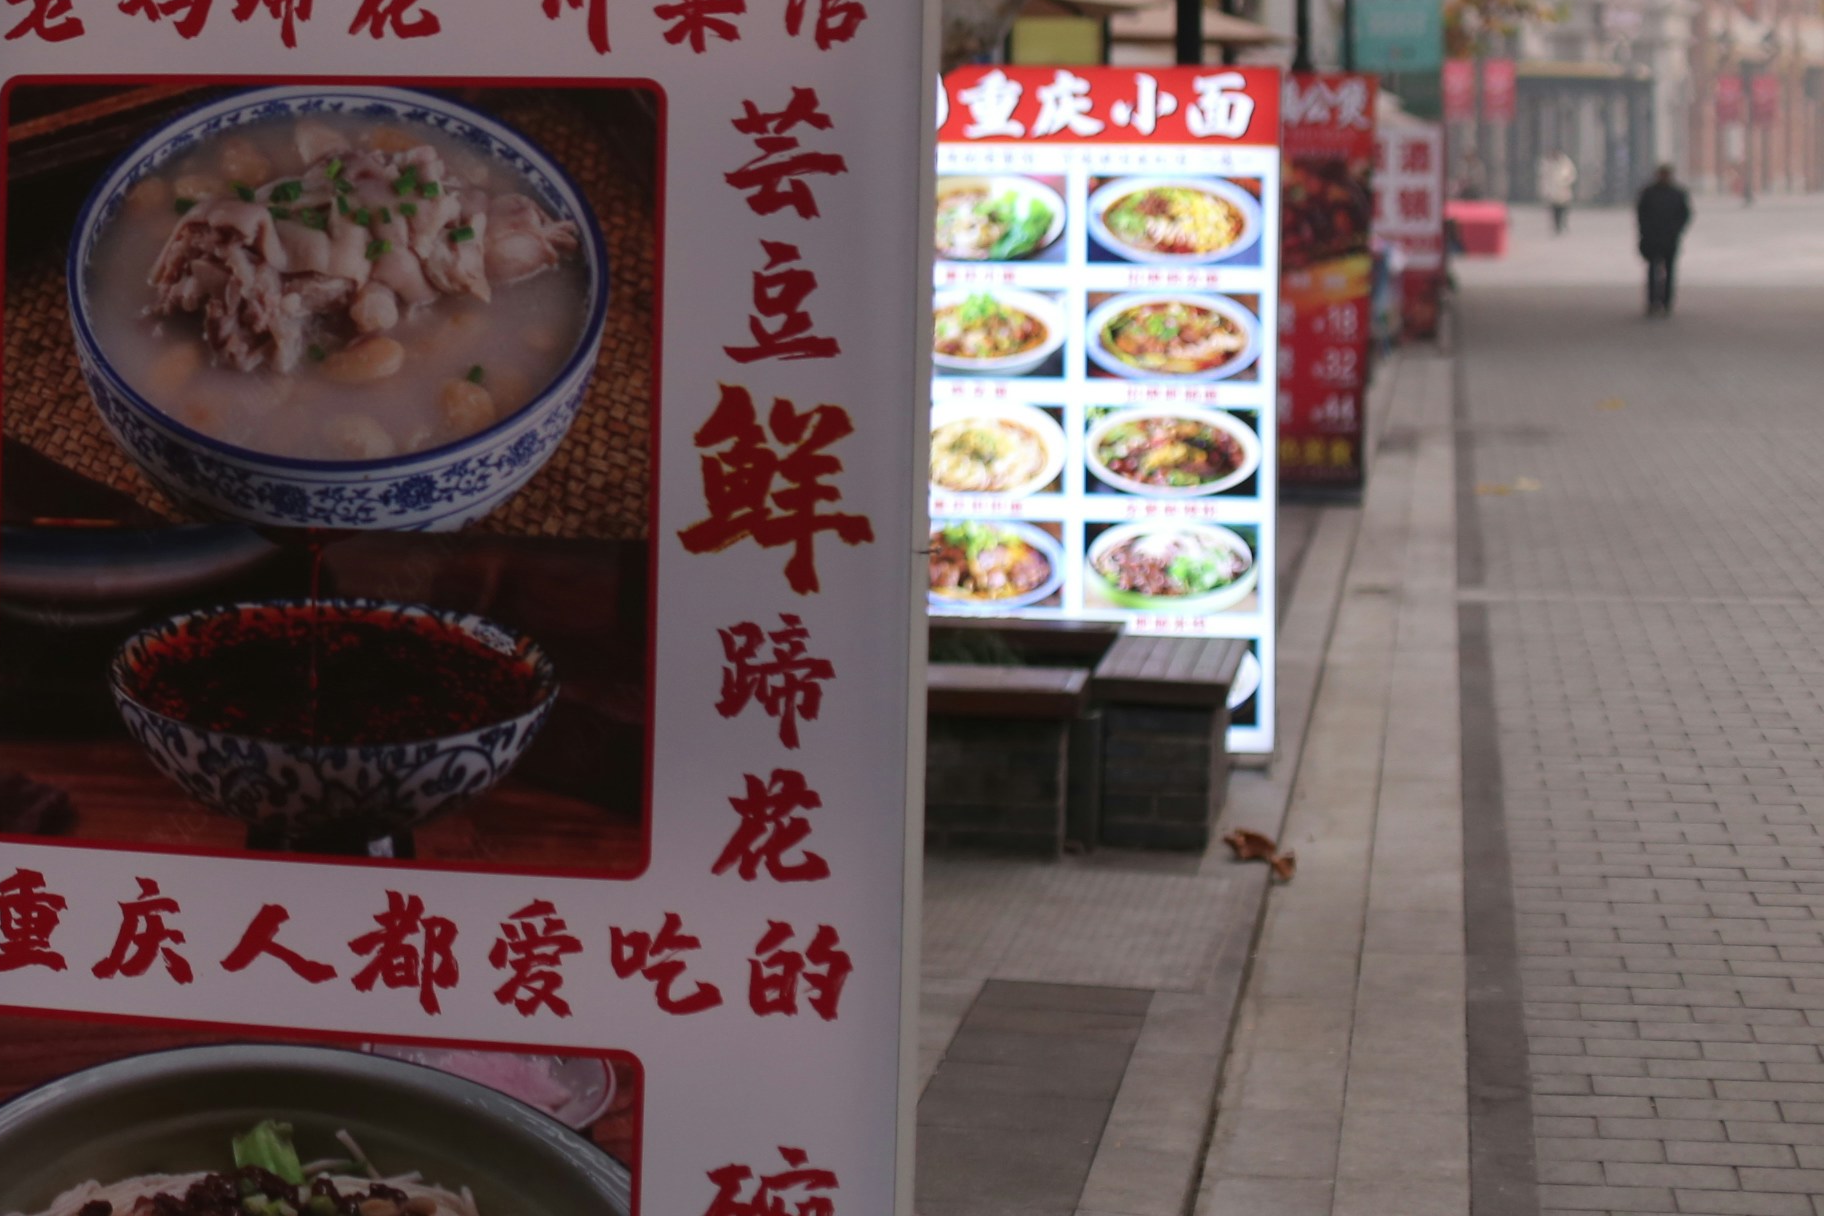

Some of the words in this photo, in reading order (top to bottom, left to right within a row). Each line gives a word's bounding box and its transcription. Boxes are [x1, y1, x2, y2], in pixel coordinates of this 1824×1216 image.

[677, 84, 875, 885] 芸豆鲜蹄花
